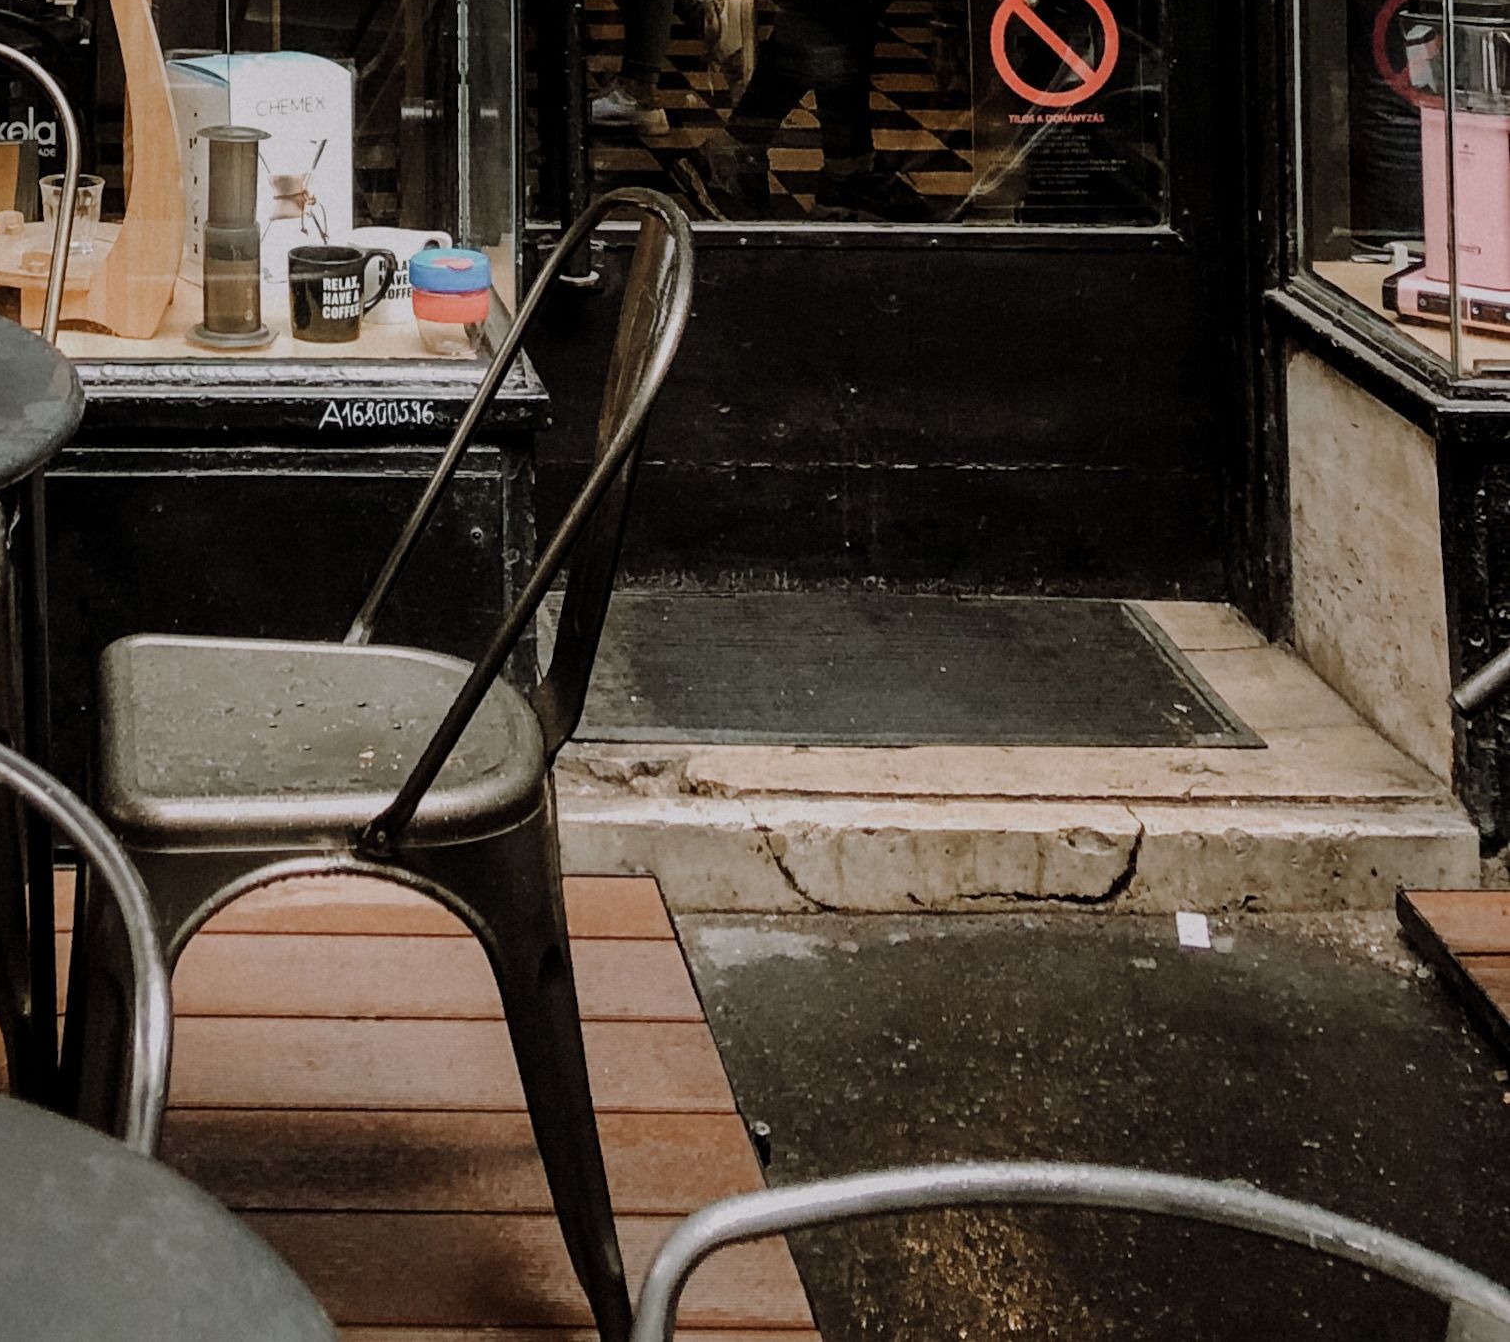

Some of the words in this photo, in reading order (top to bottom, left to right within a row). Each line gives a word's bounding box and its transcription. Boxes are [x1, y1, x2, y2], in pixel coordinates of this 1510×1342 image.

[255, 96, 326, 117] CHEMEX
[322, 291, 352, 306] HAVE
[353, 289, 359, 303] A
[322, 305, 360, 319] COFFEE
